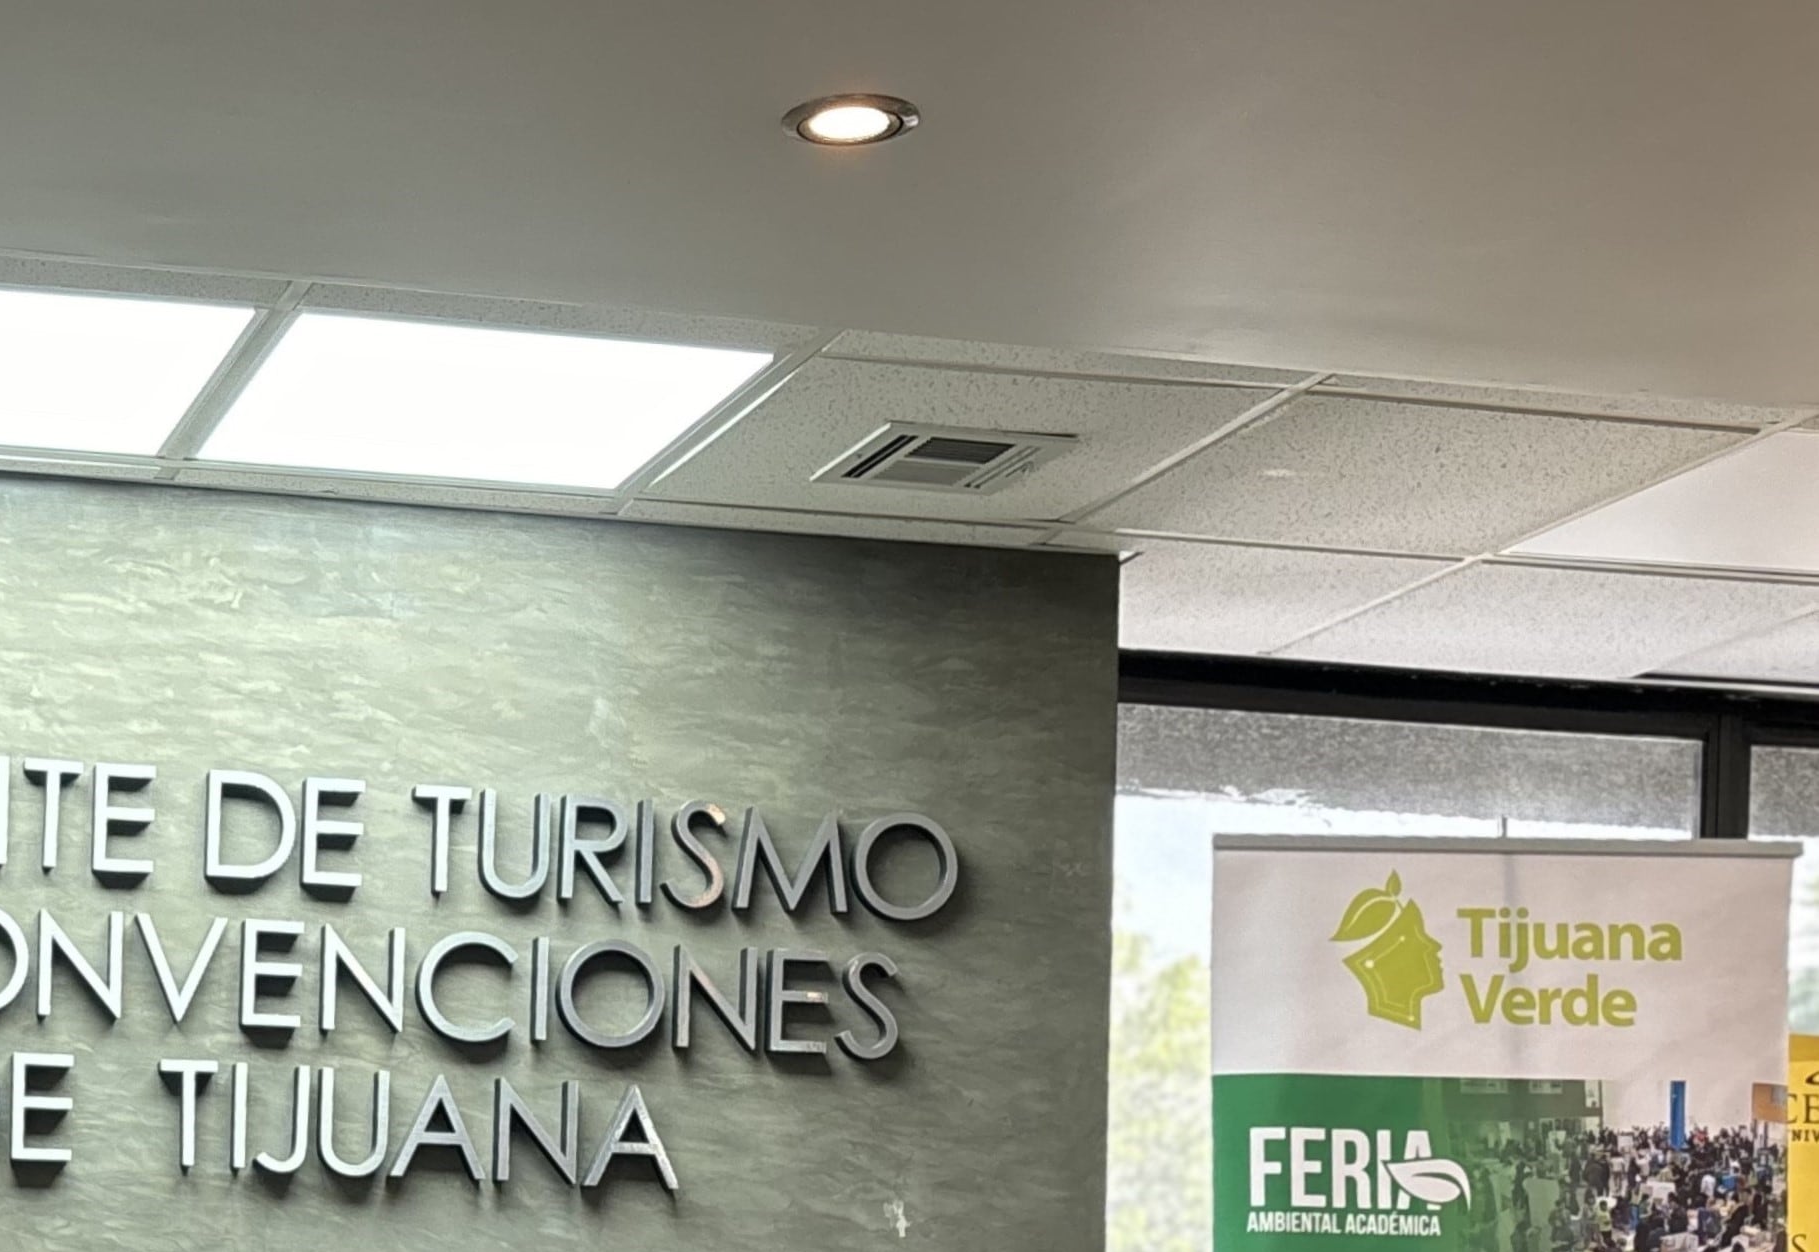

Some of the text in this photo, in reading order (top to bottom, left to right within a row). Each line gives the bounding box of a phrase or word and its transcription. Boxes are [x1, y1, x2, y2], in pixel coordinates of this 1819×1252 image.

[204, 769, 366, 888] DE
[413, 784, 959, 920] TURISMO
[1456, 907, 1683, 973] Tijuana
[1458, 974, 1638, 1027] Verde
[159, 1059, 679, 1190] TIJUANA
[1249, 1126, 1442, 1211] FERIA
[1246, 1211, 1442, 1237] AMBIENTAL ACADÉMICA
